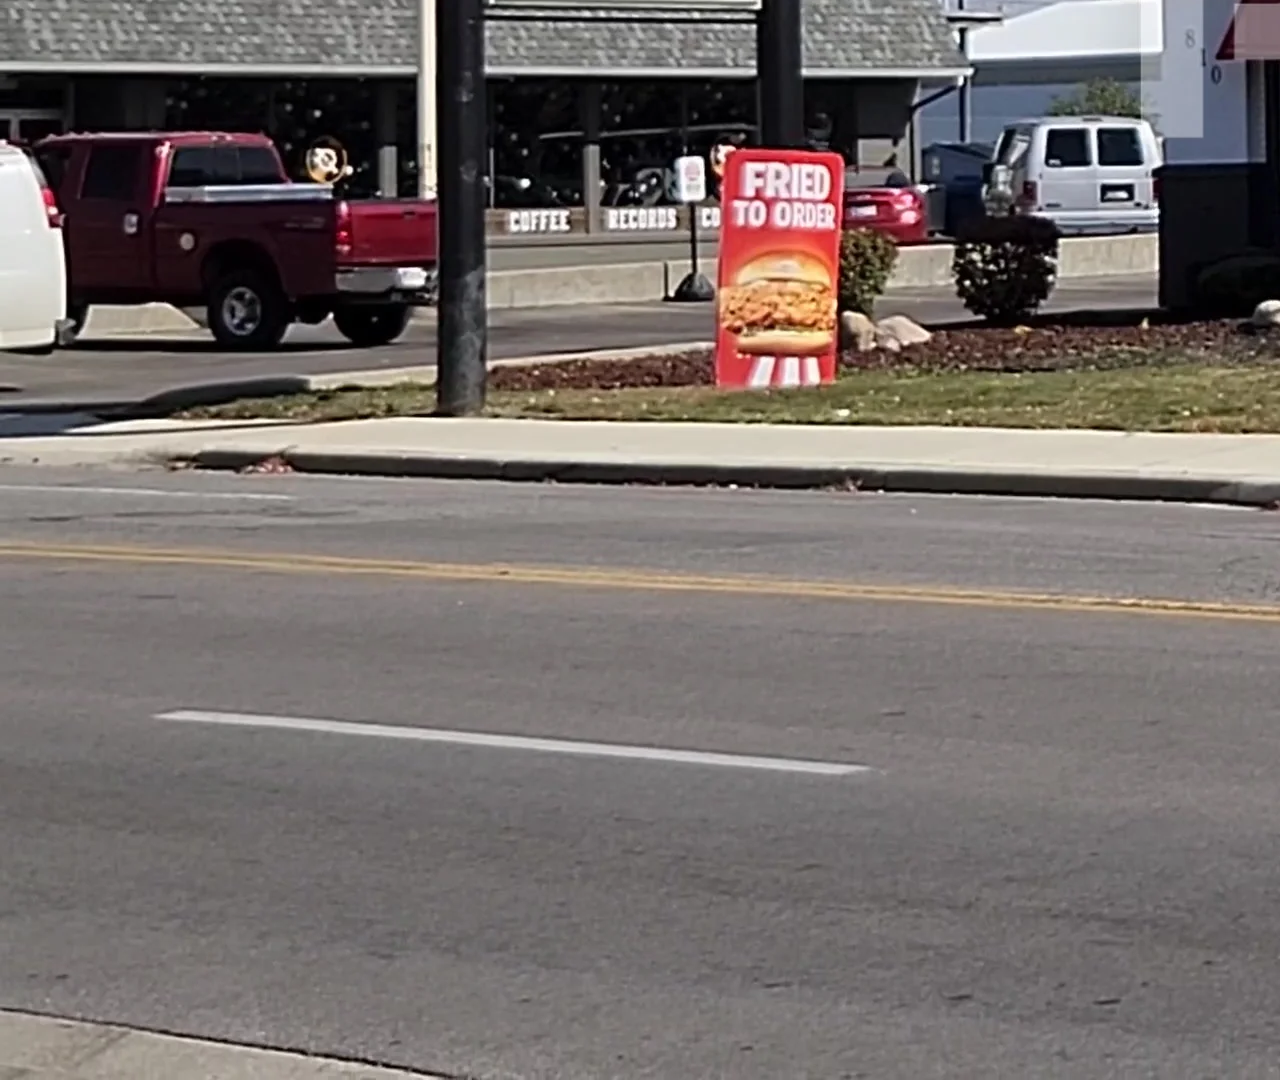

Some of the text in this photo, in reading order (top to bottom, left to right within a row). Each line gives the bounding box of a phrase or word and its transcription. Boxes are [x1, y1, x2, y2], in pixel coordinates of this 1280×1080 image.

[741, 161, 831, 201] FRIED
[508, 208, 571, 233] COFFEE
[607, 206, 677, 231] RECORDS
[732, 200, 766, 227] TO
[773, 203, 836, 230] ORDER
